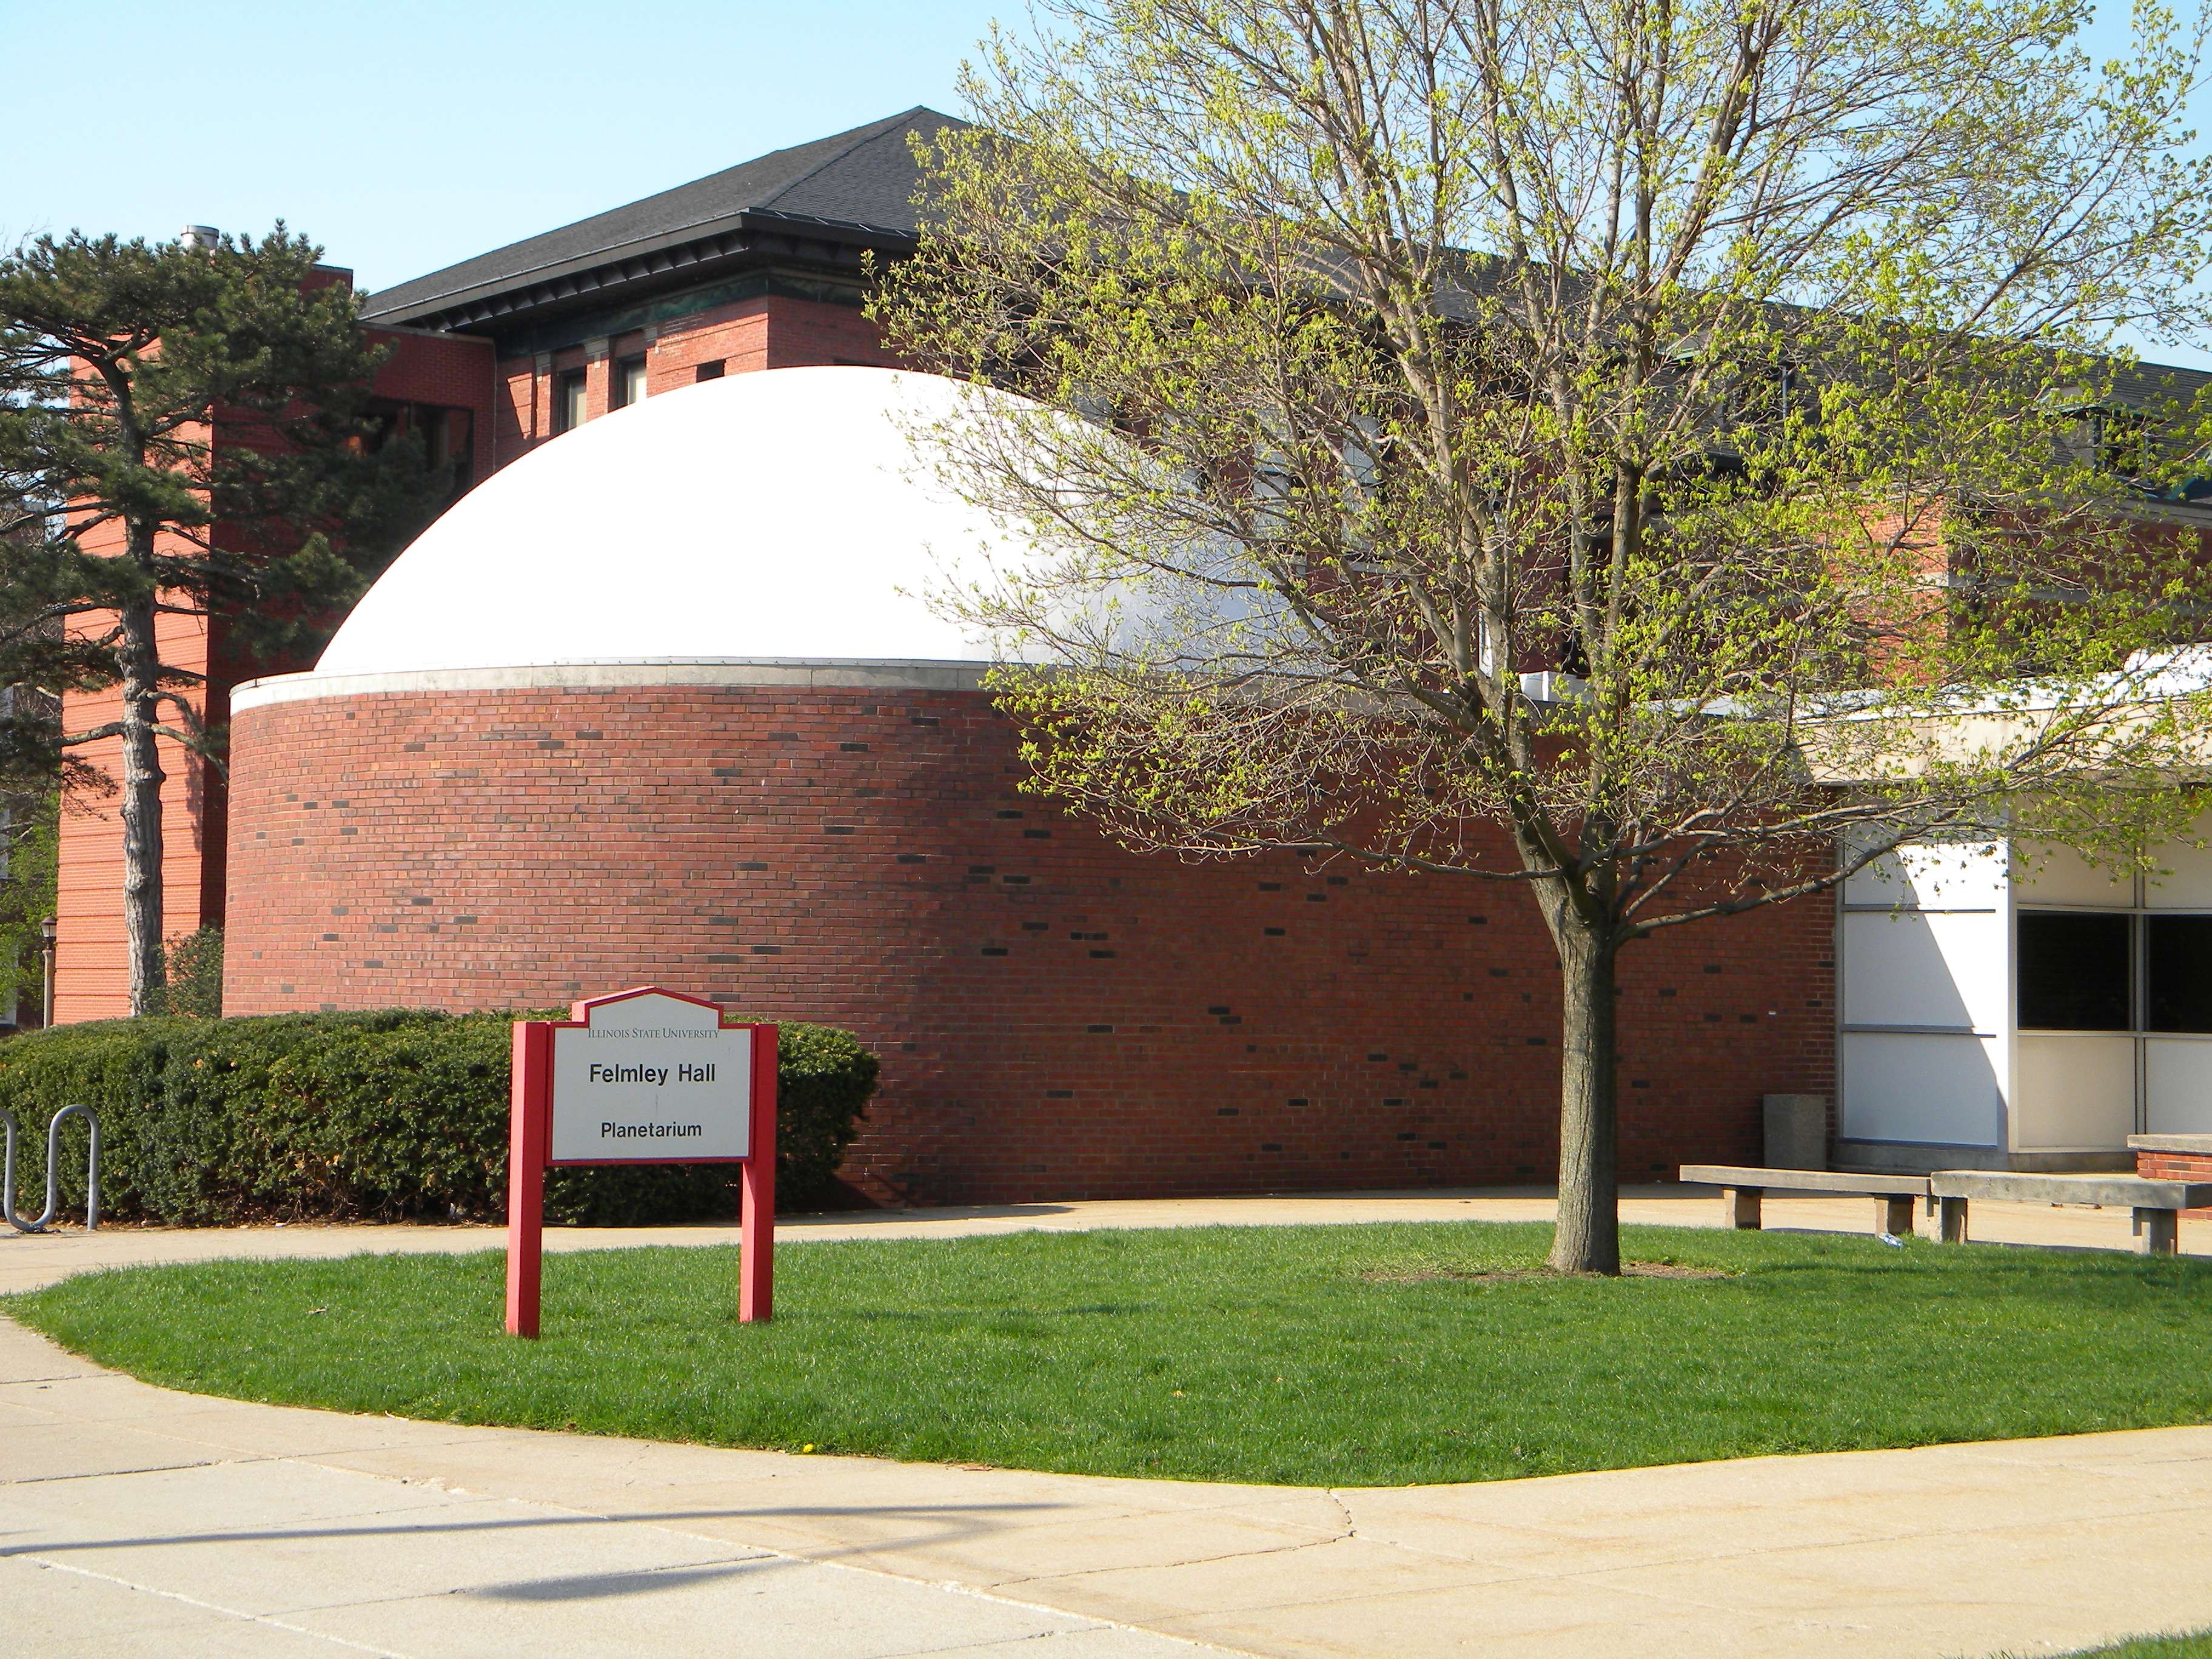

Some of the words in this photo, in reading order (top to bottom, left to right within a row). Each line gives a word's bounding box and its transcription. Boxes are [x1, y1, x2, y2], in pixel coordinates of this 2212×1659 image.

[588, 1028, 629, 1038] ILLINOIS
[632, 1028, 660, 1038] STATE
[663, 1028, 719, 1038] UNIVERSITY
[589, 1064, 668, 1086] Felmley
[679, 1064, 715, 1082] Hall
[601, 1121, 702, 1138] Planetarium
